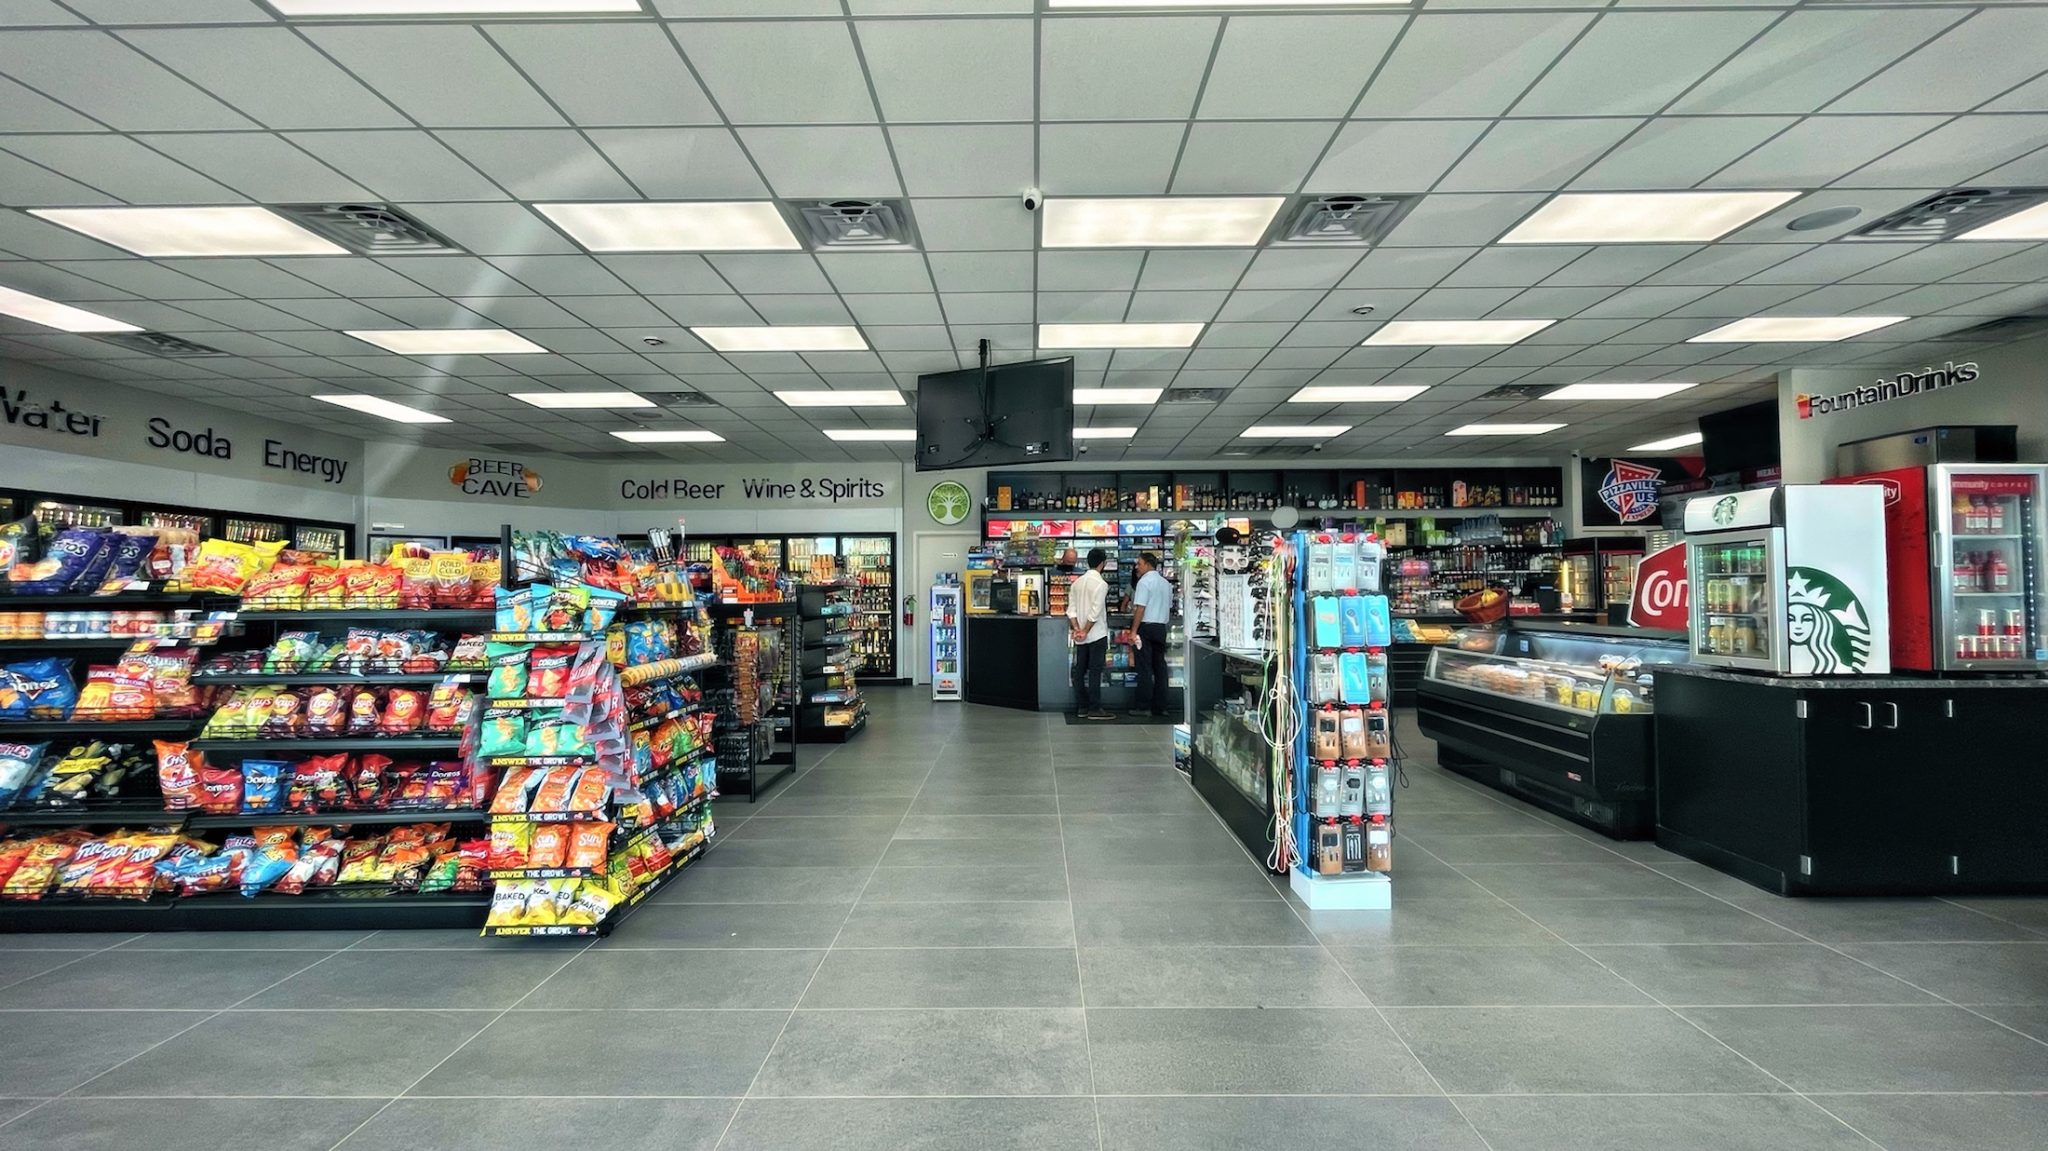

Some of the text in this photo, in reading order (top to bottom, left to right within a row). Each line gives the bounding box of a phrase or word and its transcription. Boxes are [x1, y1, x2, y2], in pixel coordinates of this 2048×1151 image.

[147, 417, 231, 460] Soda
[264, 439, 348, 484] Energy
[469, 458, 524, 480] BEER
[462, 479, 530, 498] CAVE
[621, 478, 884, 503] Cold Beer Wine & Spirits
[1602, 481, 1661, 499] PIZZAVILL
[1637, 492, 1658, 502] US
[491, 757, 568, 765] ANSWER THE GROWL
[492, 813, 568, 821] ANSWER THE GROWL
[489, 870, 566, 878] ANSWER THE GROWL
[495, 892, 525, 901] BAKED
[495, 927, 572, 935] ANSWER THE GROWL
